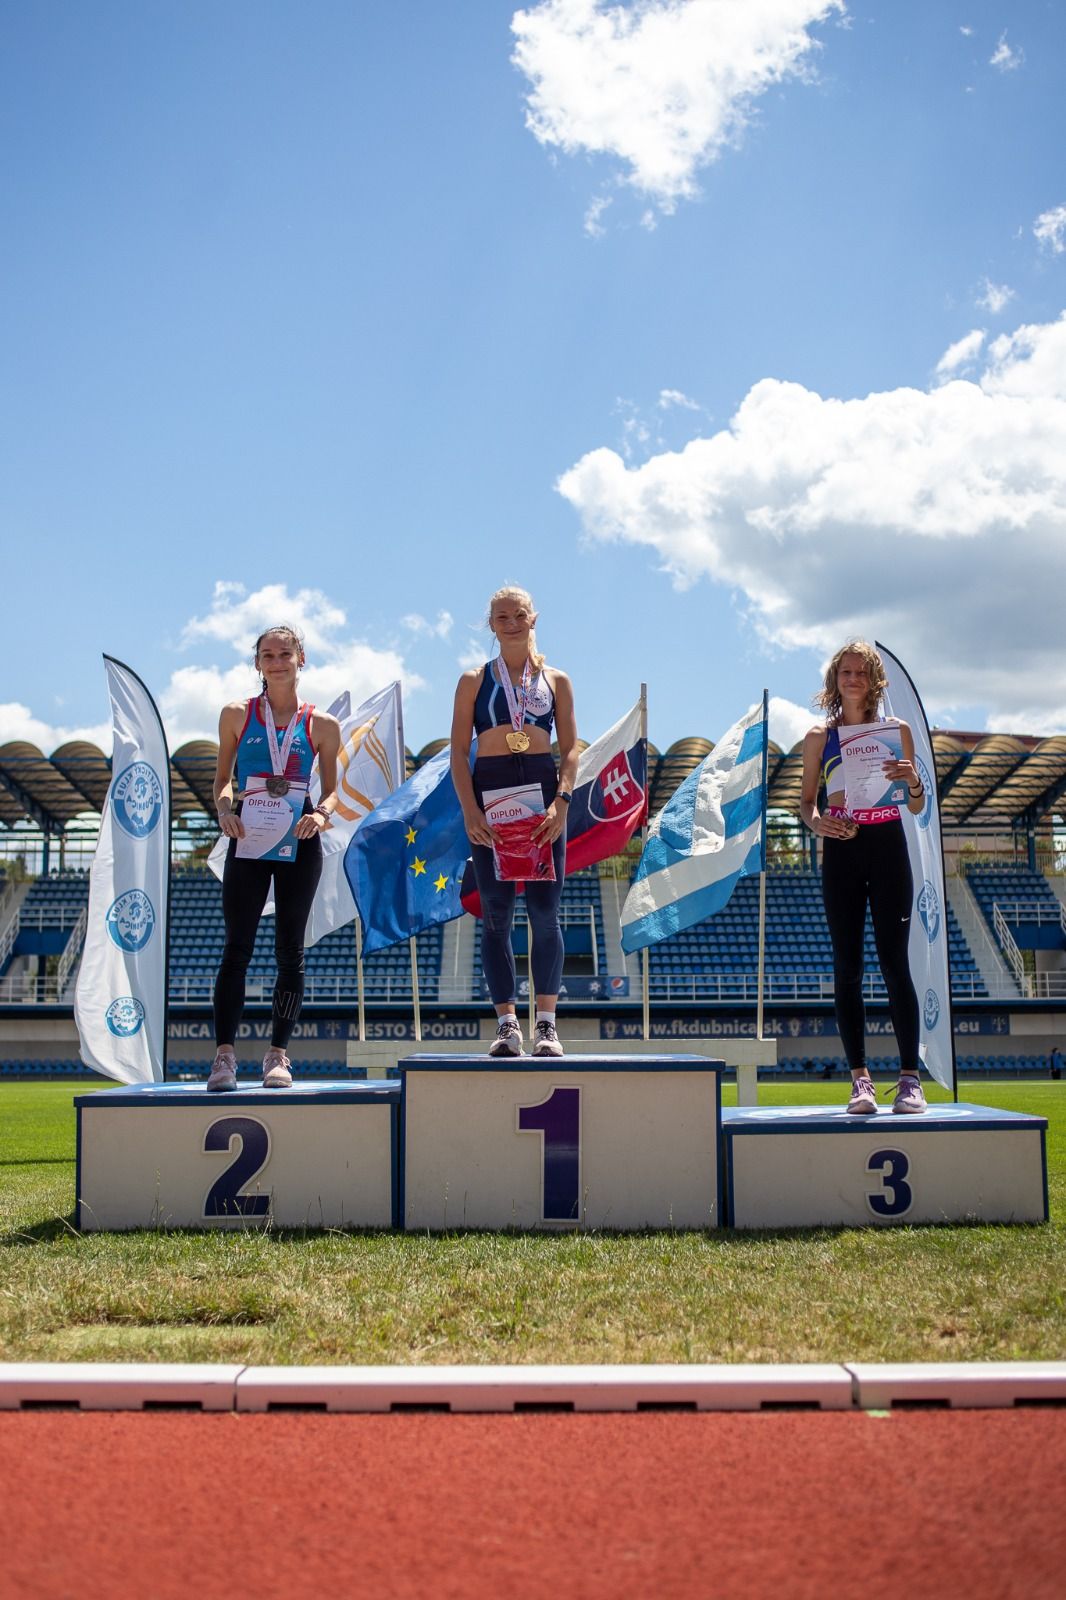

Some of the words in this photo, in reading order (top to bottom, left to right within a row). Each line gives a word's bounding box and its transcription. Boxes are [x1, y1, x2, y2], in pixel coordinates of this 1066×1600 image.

[845, 745, 880, 756] DIPLOM
[248, 798, 281, 808] DIPLOM
[490, 807, 523, 820] DIPLOM
[870, 807, 900, 821] PRO
[167, 1023, 211, 1037] NICA
[254, 1020, 318, 1037] VÁOM
[348, 1023, 407, 1037] MESTO
[409, 1023, 478, 1037] SPORTU
[622, 1019, 783, 1035] www.fkdubnicask
[517, 1087, 581, 1221] 1
[204, 1116, 270, 1218] 2
[866, 1148, 913, 1217] 3
